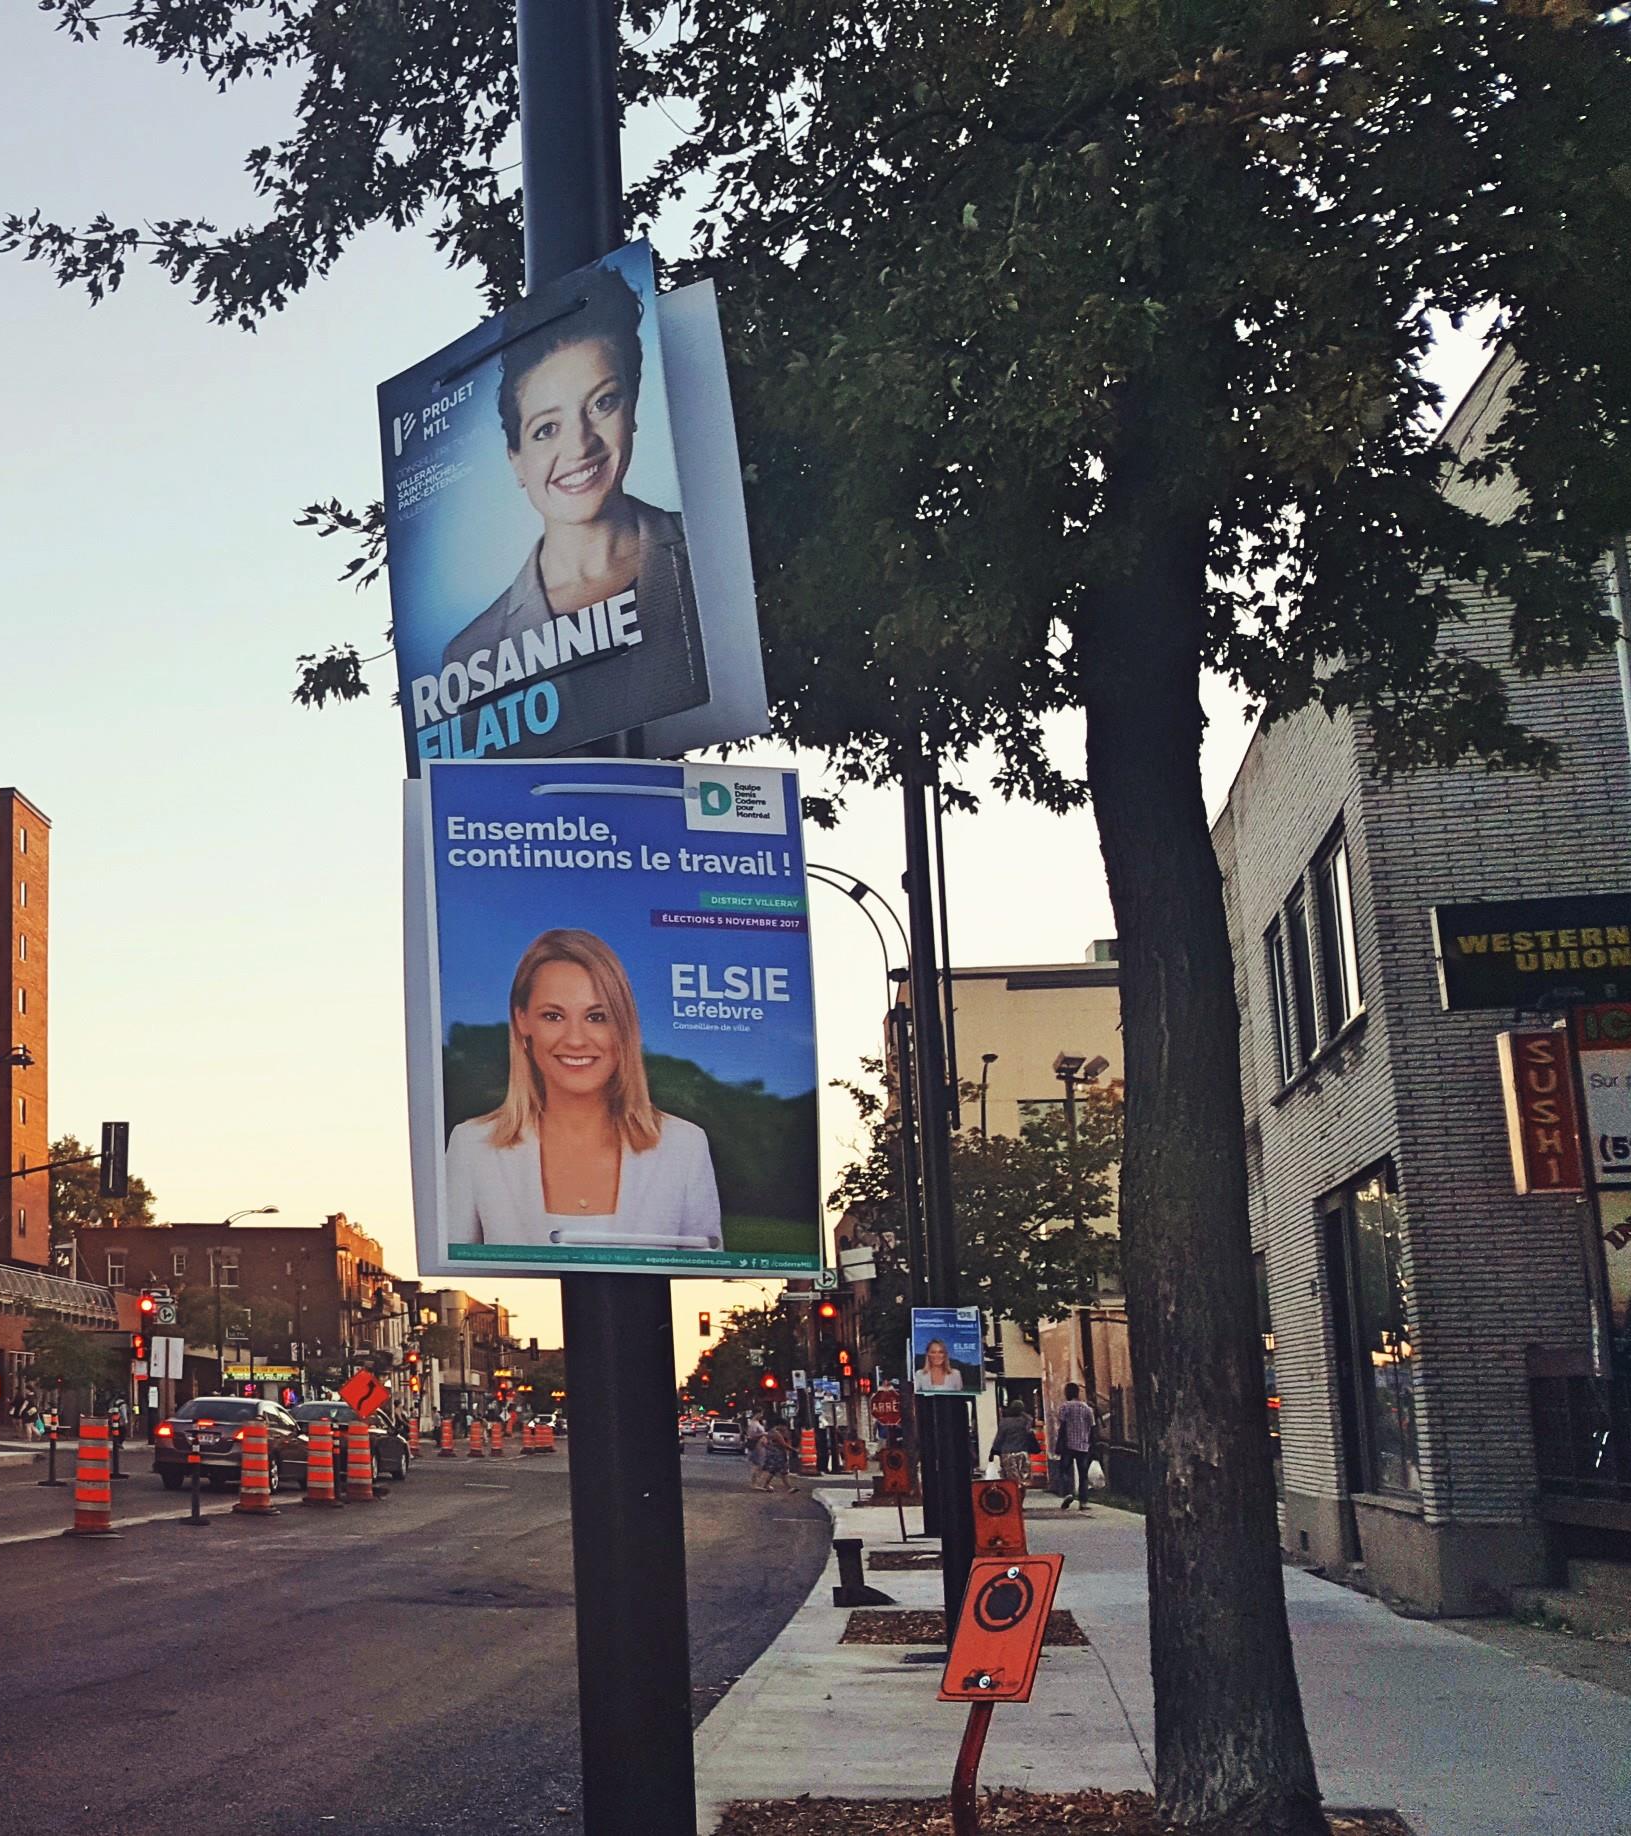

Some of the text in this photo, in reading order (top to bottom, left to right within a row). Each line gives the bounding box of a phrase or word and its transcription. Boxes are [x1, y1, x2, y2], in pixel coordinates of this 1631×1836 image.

[422, 381, 474, 424] PROJET
[423, 416, 451, 441] MTL
[411, 589, 643, 729] ROSANNIE
[417, 680, 560, 759] FILATO
[734, 782, 761, 791] Équipe
[737, 811, 770, 819] Montréal
[447, 816, 618, 846] Ensemble,
[448, 843, 791, 877] continuons le travail !
[711, 896, 799, 908] DISTRICT VILLERAY
[662, 914, 715, 924] ÉLECTIONS
[725, 917, 777, 927] NOVEMBRE
[1457, 925, 1630, 954] WESTERN
[1516, 946, 1631, 971] UNION
[671, 964, 790, 1002] ELSIE
[673, 1000, 764, 1020] Lefebvre
[720, 1023, 731, 1031] de
[733, 1024, 751, 1032] ville
[1591, 1073, 1619, 1088] Sur
[1526, 1040, 1563, 1184] SUSHI
[872, 1399, 900, 1412] ARRÊ
